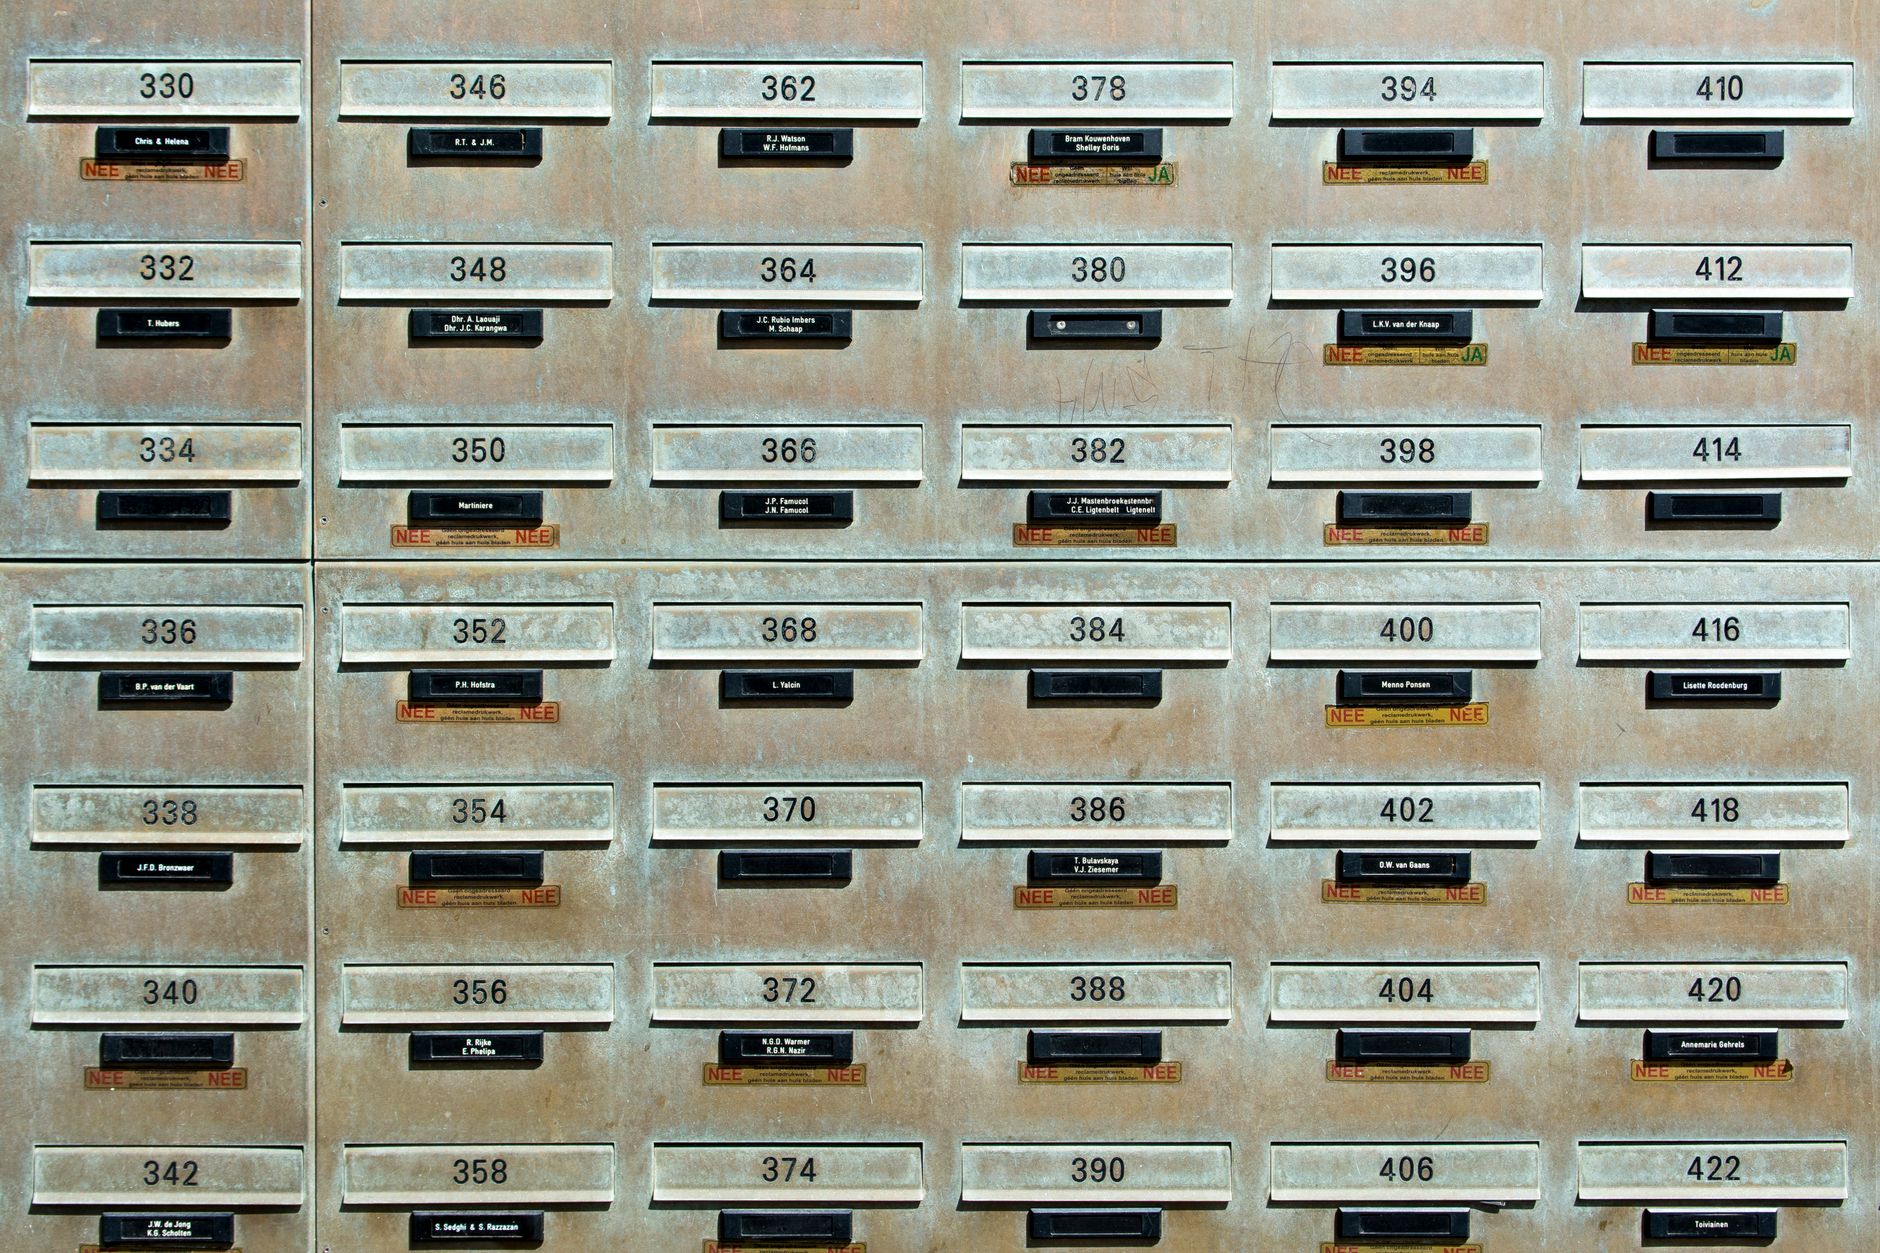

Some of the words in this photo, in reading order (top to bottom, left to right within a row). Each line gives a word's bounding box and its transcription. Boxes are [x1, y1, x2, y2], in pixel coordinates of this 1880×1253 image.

[141, 73, 193, 98] 330
[450, 74, 505, 99] 346
[762, 75, 815, 101] 362
[1072, 76, 1125, 100] 378
[1382, 76, 1436, 101] 394
[1697, 75, 1743, 100] 410
[134, 137, 154, 146] Chris
[155, 137, 162, 146] &
[164, 137, 190, 146] Helena
[454, 138, 468, 146] R.T.
[471, 138, 477, 146] &
[479, 138, 495, 146] J.M.
[766, 134, 780, 144] R.J.
[780, 134, 806, 143] Watson
[1064, 134, 1084, 143] Bram
[1084, 134, 1131, 143] Kouwenhoven
[762, 143, 779, 152] W.F.
[779, 143, 810, 152] Hofmans
[1075, 143, 1101, 153] Shelley
[1017, 167, 1050, 182] NEE
[1148, 167, 1169, 182] JA
[140, 255, 193, 280] 332
[451, 256, 506, 281] 348
[761, 257, 816, 282] 364
[1072, 257, 1125, 282] 380
[1382, 258, 1435, 282] 396
[1696, 256, 1742, 281] 412
[147, 319, 154, 327] T.
[154, 319, 180, 327] Hubers
[451, 315, 466, 323] Dhr.
[466, 315, 475, 323] A.
[756, 316, 770, 324] J.C.
[771, 316, 791, 324] Rubio
[791, 316, 816, 324] Imbers
[1372, 320, 1392, 328] L.K.V.
[1392, 320, 1405, 328] van
[1405, 320, 1418, 328] der
[1418, 320, 1440, 329] Knaap
[443, 324, 459, 333] Dhr.
[459, 324, 473, 333] J.C.
[474, 324, 508, 334] Karangwa
[768, 325, 777, 333] M.
[778, 325, 803, 334] Schaap
[1329, 348, 1362, 361] NEE
[1461, 347, 1482, 362] JA
[1638, 348, 1671, 361] NEE
[1770, 347, 1791, 361] JA
[140, 437, 195, 462] 334
[452, 437, 505, 462] 350
[762, 438, 816, 463] 366
[1072, 438, 1124, 463] 382
[1381, 438, 1434, 463] 398
[1693, 437, 1741, 461] 414
[458, 501, 494, 509] Martiniere
[764, 497, 779, 505] J.P.
[1066, 497, 1080, 505] J.J.
[764, 506, 779, 514] J.N.
[1070, 506, 1084, 515] C.E.
[397, 530, 430, 543] NEE
[516, 530, 549, 543] NEE
[142, 619, 196, 644] 336
[454, 618, 505, 643] 352
[762, 617, 816, 642] 368
[1070, 617, 1125, 641] 384
[1380, 617, 1433, 642] 400
[1692, 617, 1739, 641] 416
[135, 682, 149, 691] B.P.
[149, 682, 163, 691] van
[163, 682, 176, 691] der
[175, 682, 195, 691] Vaart
[455, 681, 469, 689] P.H.
[470, 681, 496, 689] Hofstra
[772, 681, 779, 689] L.
[779, 681, 801, 689] Yalcin
[1381, 680, 1405, 689] Menno
[1405, 680, 1431, 689] Ponsen
[1682, 681, 1707, 690] Lisette
[1707, 681, 1748, 691] Roodenburg
[401, 705, 434, 718] NEE
[521, 706, 554, 719] NEE
[1331, 709, 1364, 722] NEE
[1450, 708, 1483, 721] NEE
[143, 800, 197, 825] 338
[453, 799, 507, 823] 354
[764, 796, 815, 822] 370
[1071, 797, 1125, 822] 386
[1380, 797, 1433, 822] 402
[1691, 797, 1739, 822] 418
[157, 863, 195, 872] Bronzwaer
[1074, 856, 1081, 865] T.
[1081, 856, 1119, 866] Bulavskaya
[1395, 861, 1408, 869] van
[1073, 865, 1087, 875] V.J.
[1087, 865, 1119, 874] Ziesemer
[403, 890, 436, 903] NEE
[522, 890, 555, 903] NEE
[1020, 890, 1053, 904] NEE
[1139, 890, 1172, 903] NEE
[143, 979, 197, 1004] 340
[453, 979, 507, 1004] 356
[763, 977, 815, 1002] 372
[1071, 976, 1125, 1001] 388
[1379, 977, 1433, 1002] 404
[1689, 977, 1741, 1002] 420
[466, 1038, 474, 1046] R.
[474, 1038, 492, 1047] Rijke
[783, 1037, 811, 1046] Warmer
[1680, 1040, 1718, 1049] Annemarie
[1718, 1040, 1745, 1049] Gehrels
[461, 1047, 469, 1056] E.
[470, 1047, 496, 1057] Phelipa
[766, 1046, 787, 1055] R.G.N.
[788, 1046, 806, 1055] Nazir
[709, 1068, 742, 1080] NEE
[828, 1069, 861, 1081] NEE
[144, 1160, 198, 1186] 342
[453, 1159, 507, 1184] 358
[762, 1157, 816, 1182] 374
[1072, 1157, 1124, 1182] 390
[1380, 1156, 1433, 1181] 406
[1688, 1156, 1740, 1180] 422
[147, 1220, 163, 1228] J.W.
[163, 1220, 174, 1228] de
[173, 1220, 192, 1229] Jong
[434, 1223, 442, 1232] S.
[442, 1223, 467, 1233] Sedghi
[469, 1223, 476, 1232] &
[478, 1223, 486, 1232] S.
[486, 1223, 519, 1232] Razzazan
[1694, 1221, 1729, 1229] Toiviainen
[146, 1229, 161, 1237] K.G.
[161, 1229, 192, 1237] Scholten
